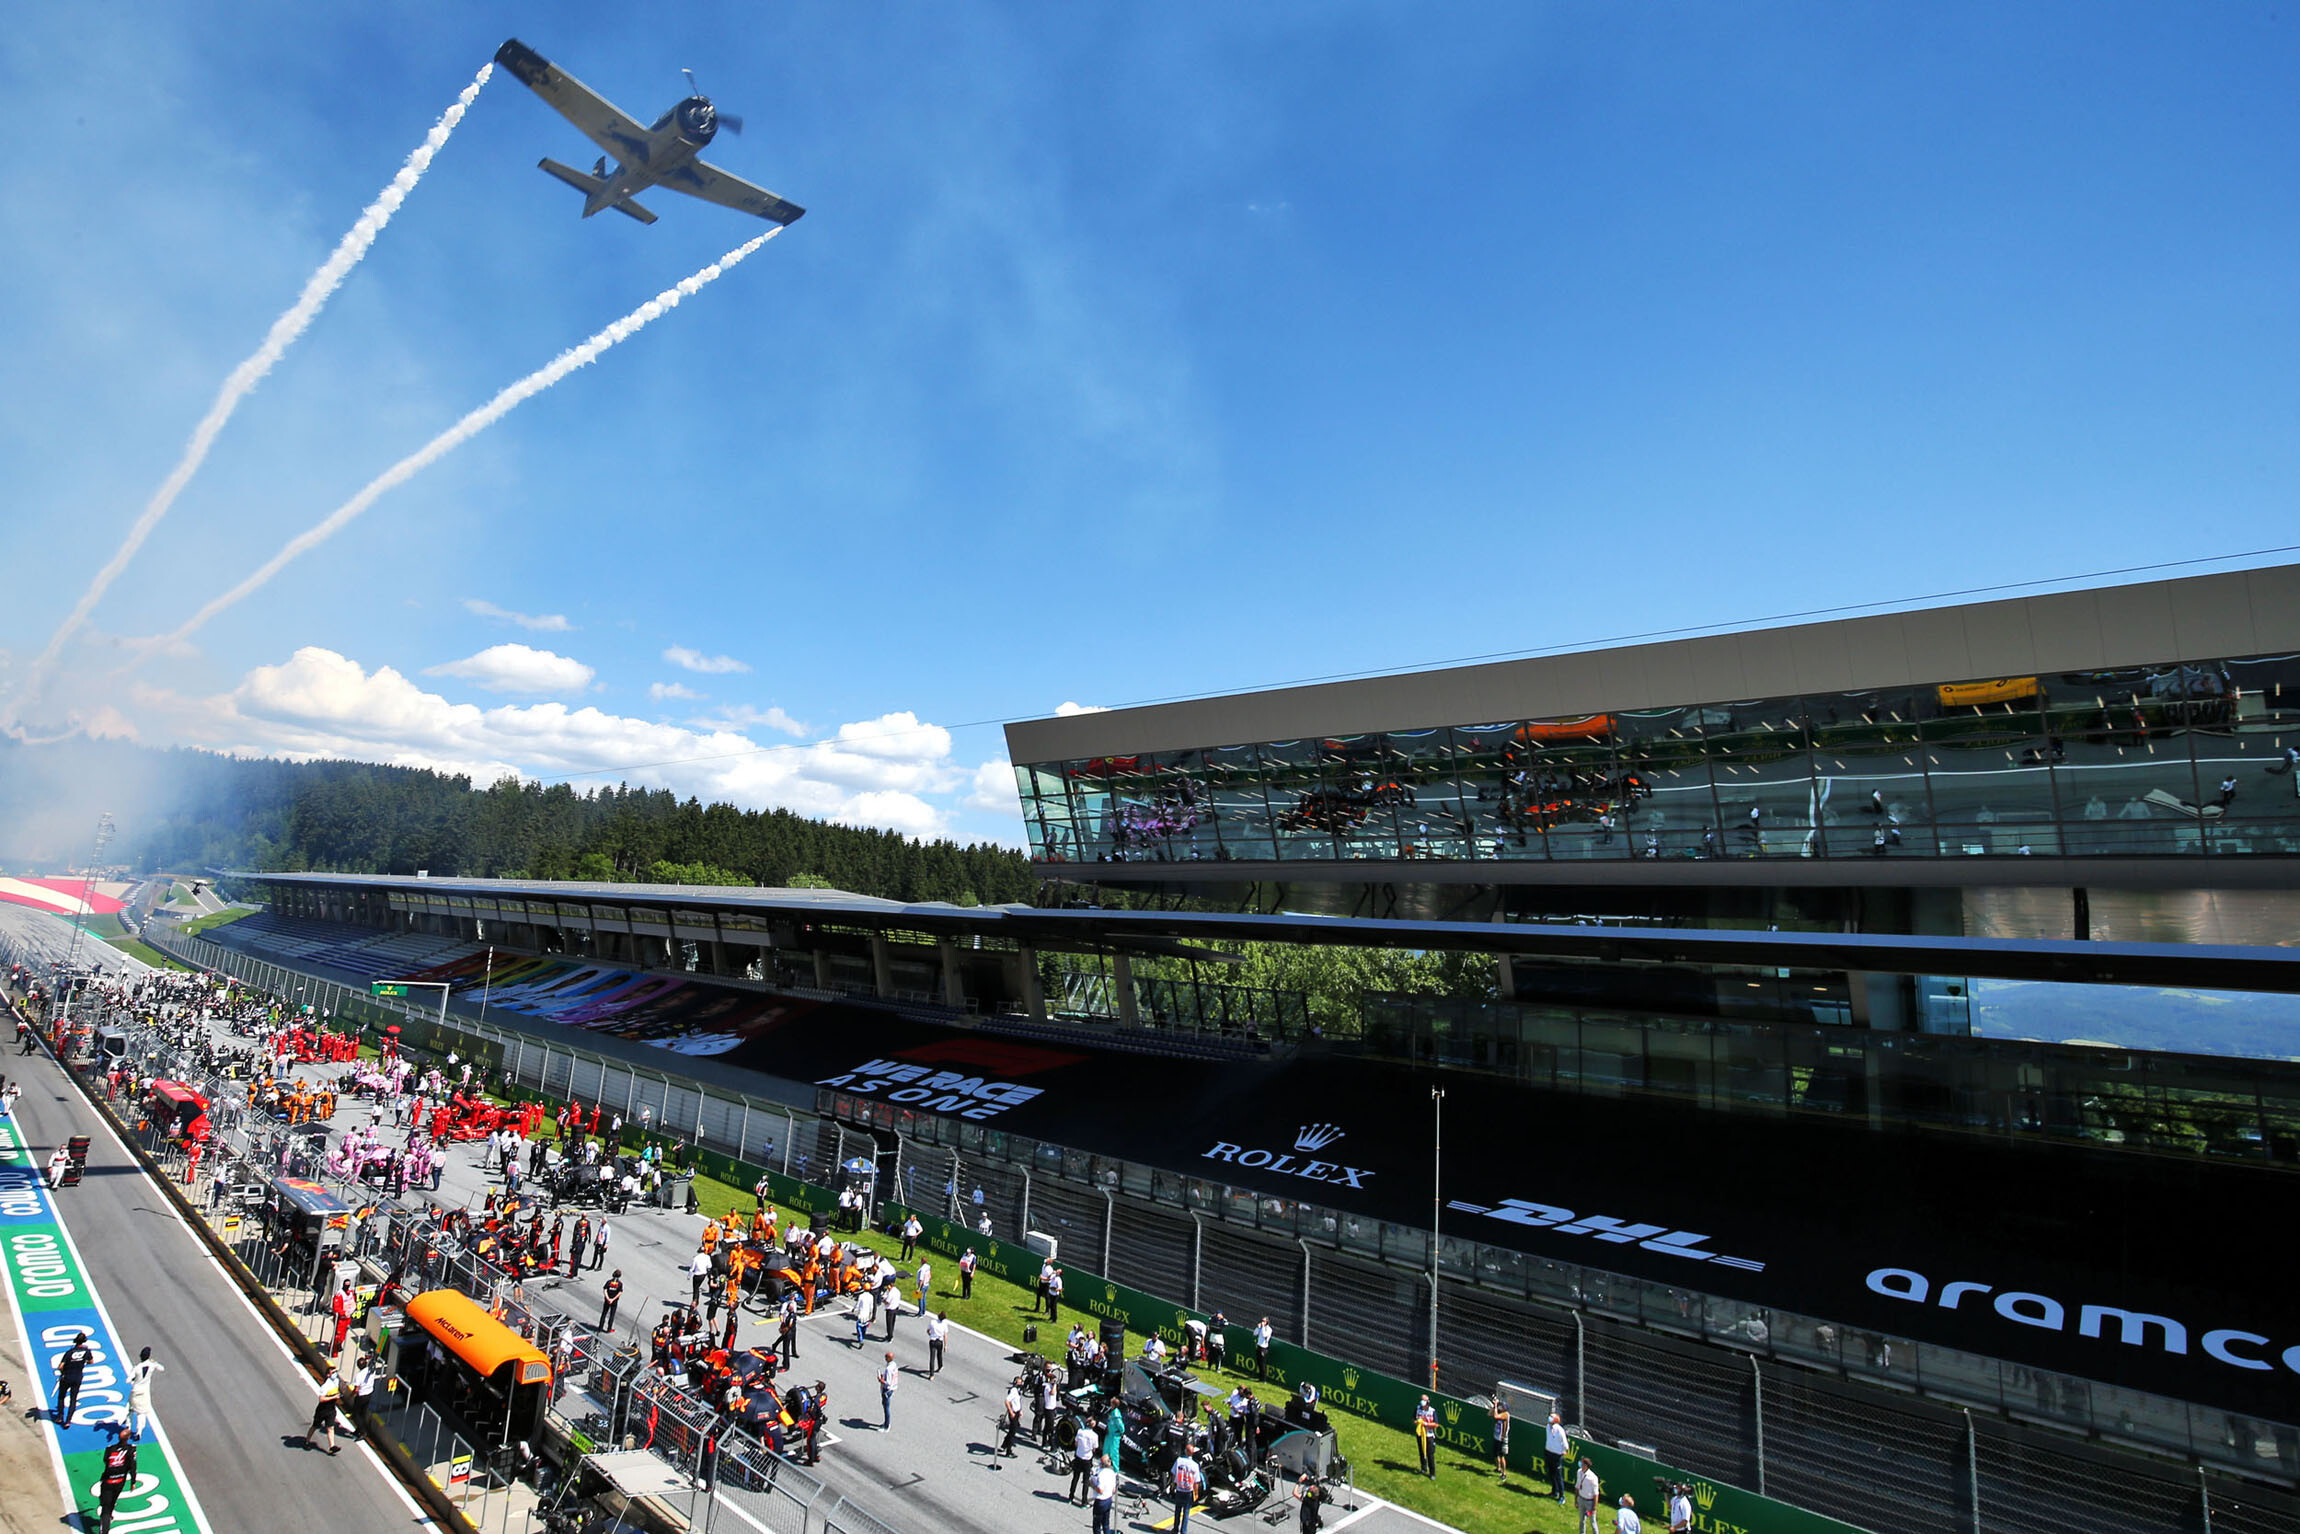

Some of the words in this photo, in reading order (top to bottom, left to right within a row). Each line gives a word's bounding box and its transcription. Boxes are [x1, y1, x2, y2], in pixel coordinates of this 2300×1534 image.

[814, 1074, 893, 1093] AS
[888, 1088, 1011, 1120] ONE
[850, 1059, 934, 1083] WE
[915, 1071, 1045, 1106] RACE
[1201, 1141, 1376, 1189] ROLEX
[789, 1196, 813, 1212] ROLEX
[1482, 1198, 1718, 1260] DHL
[931, 1236, 960, 1256] ROLEX
[10, 1233, 76, 1298] aramco
[977, 1255, 1009, 1276] ROLEX
[1089, 1299, 1130, 1324] ROLEX
[1866, 1267, 2300, 1376] aramc
[435, 1317, 465, 1341] McLaren
[1158, 1325, 1189, 1346] ROL
[1234, 1353, 1287, 1384] ROEX
[1322, 1385, 1379, 1417] ROLEX
[1434, 1423, 1486, 1455] OLEX
